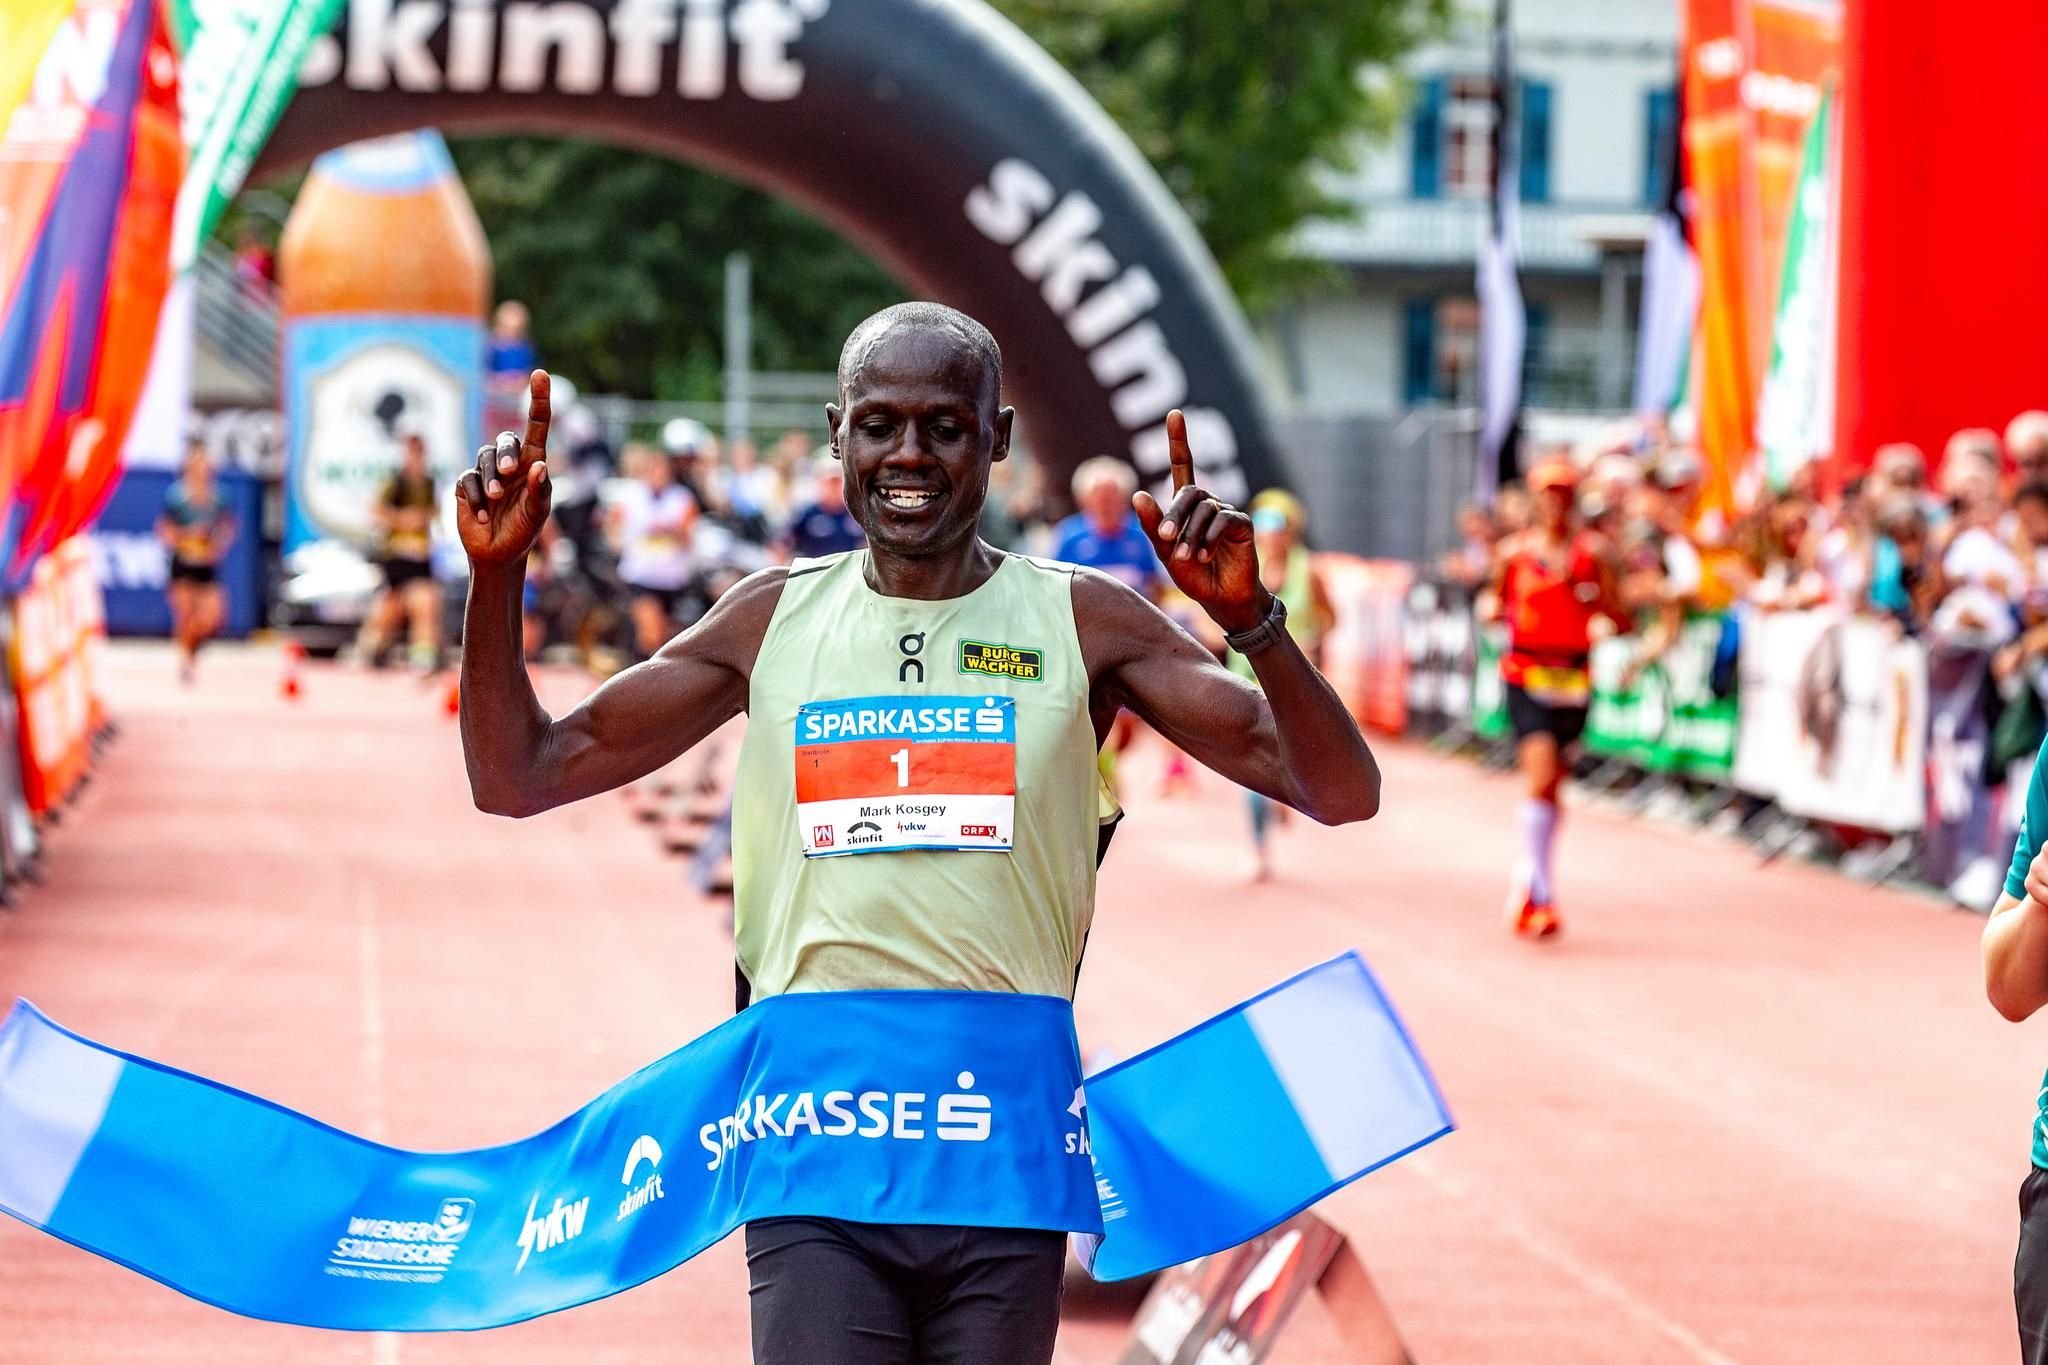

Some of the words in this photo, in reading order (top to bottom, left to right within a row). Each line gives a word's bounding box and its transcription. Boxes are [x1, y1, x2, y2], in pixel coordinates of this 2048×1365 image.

[300, 0, 805, 99] kinfit
[964, 157, 1249, 512] skinf
[967, 656, 1035, 677] WÄCHTER
[982, 647, 1021, 662] BURG
[805, 707, 970, 739] SPARKASSE
[890, 748, 909, 788] 1
[860, 805, 891, 818] Mark
[895, 804, 946, 817] Kosgey
[847, 834, 883, 845] skinfit
[962, 827, 984, 836] ORF
[616, 1174, 665, 1222] skinfit
